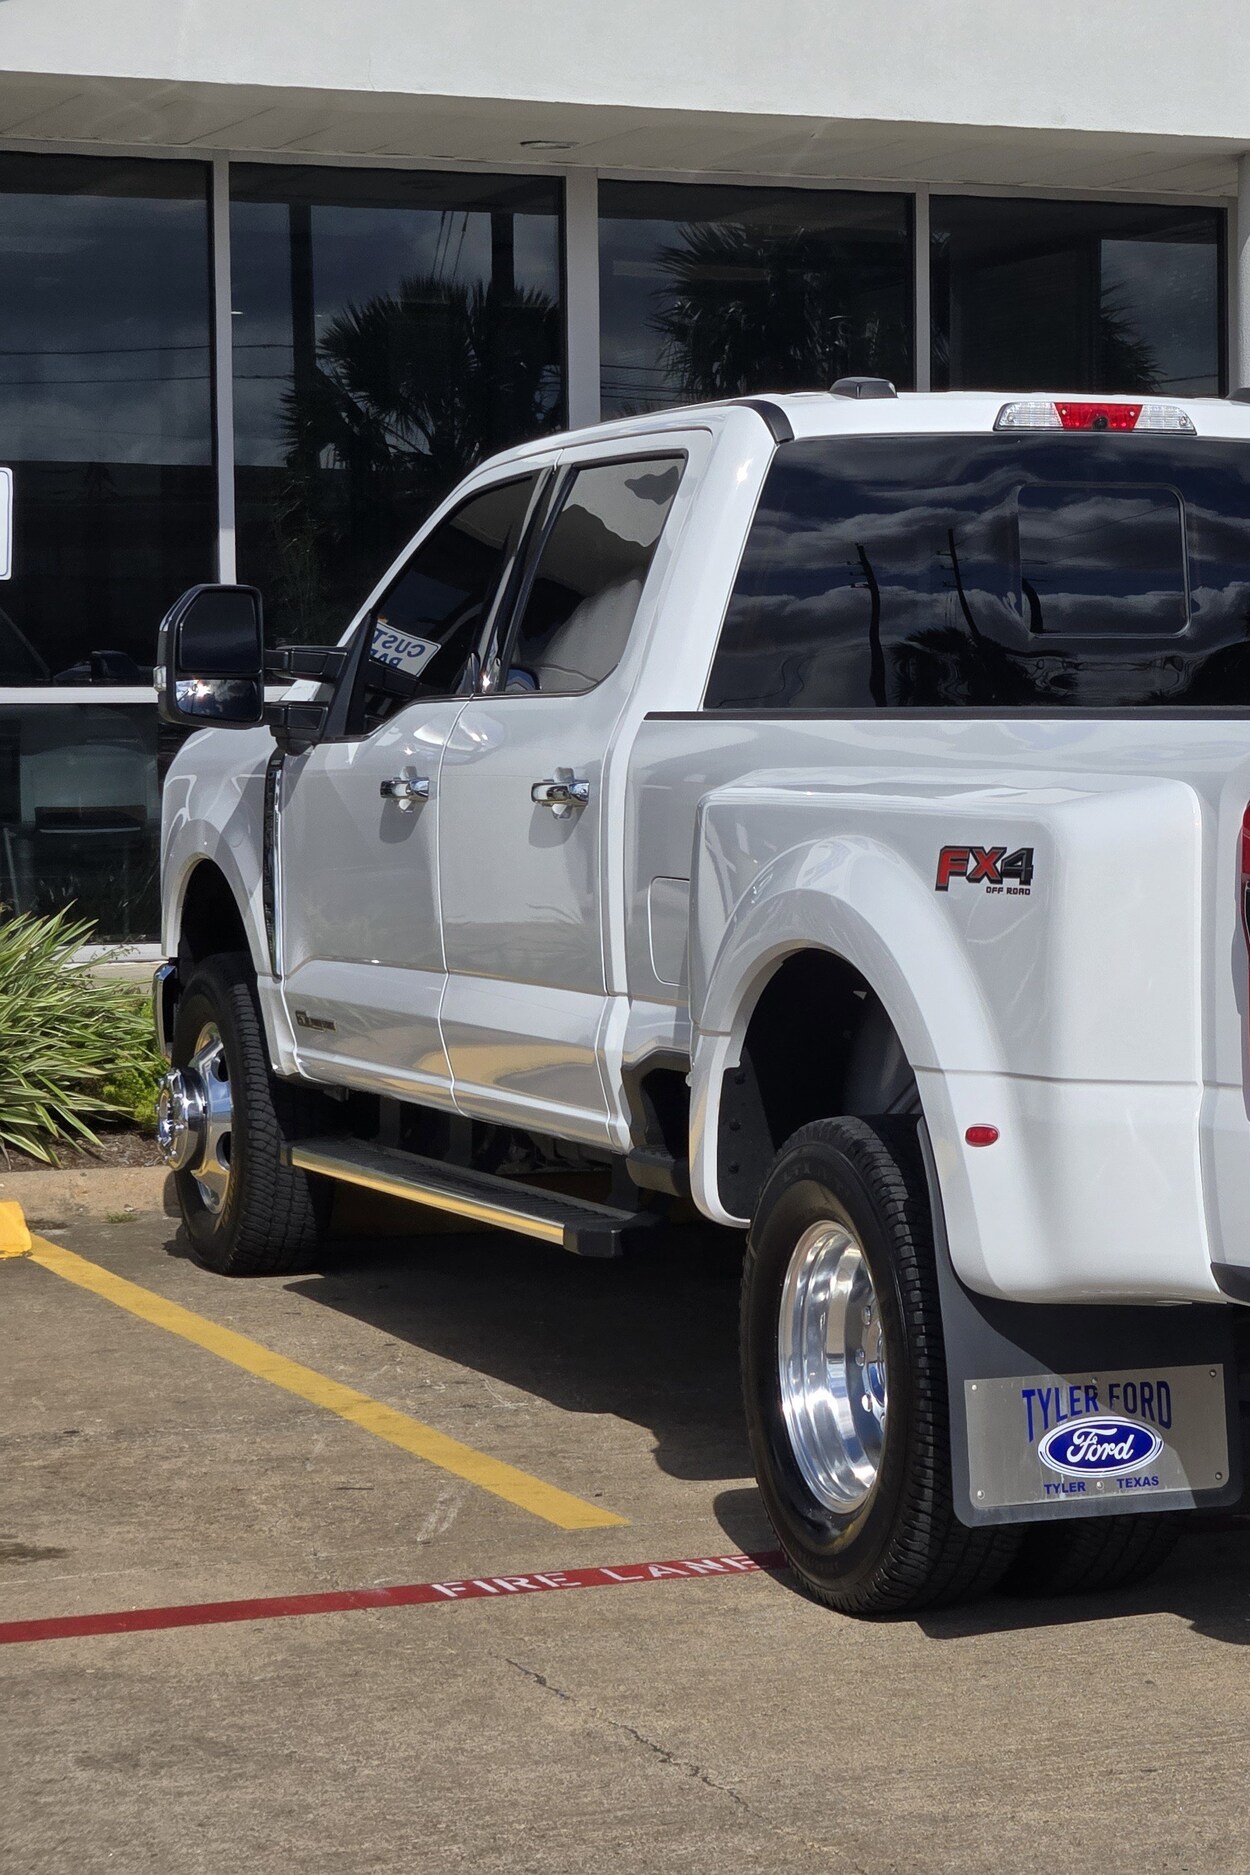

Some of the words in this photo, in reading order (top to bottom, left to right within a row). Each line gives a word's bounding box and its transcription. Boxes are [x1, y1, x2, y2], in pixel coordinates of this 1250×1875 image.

[935, 845, 1034, 892] FX4
[985, 885, 1004, 895] OFF
[1006, 886, 1031, 896] ROAD
[1022, 1385, 1099, 1443] TYLER
[1108, 1380, 1173, 1430] FORD
[1066, 1427, 1135, 1463] Ford
[1044, 1481, 1086, 1495] TYLER
[1116, 1475, 1160, 1489] TEXAS
[431, 1572, 582, 1599] FIRE
[600, 1555, 769, 1583] LANE
